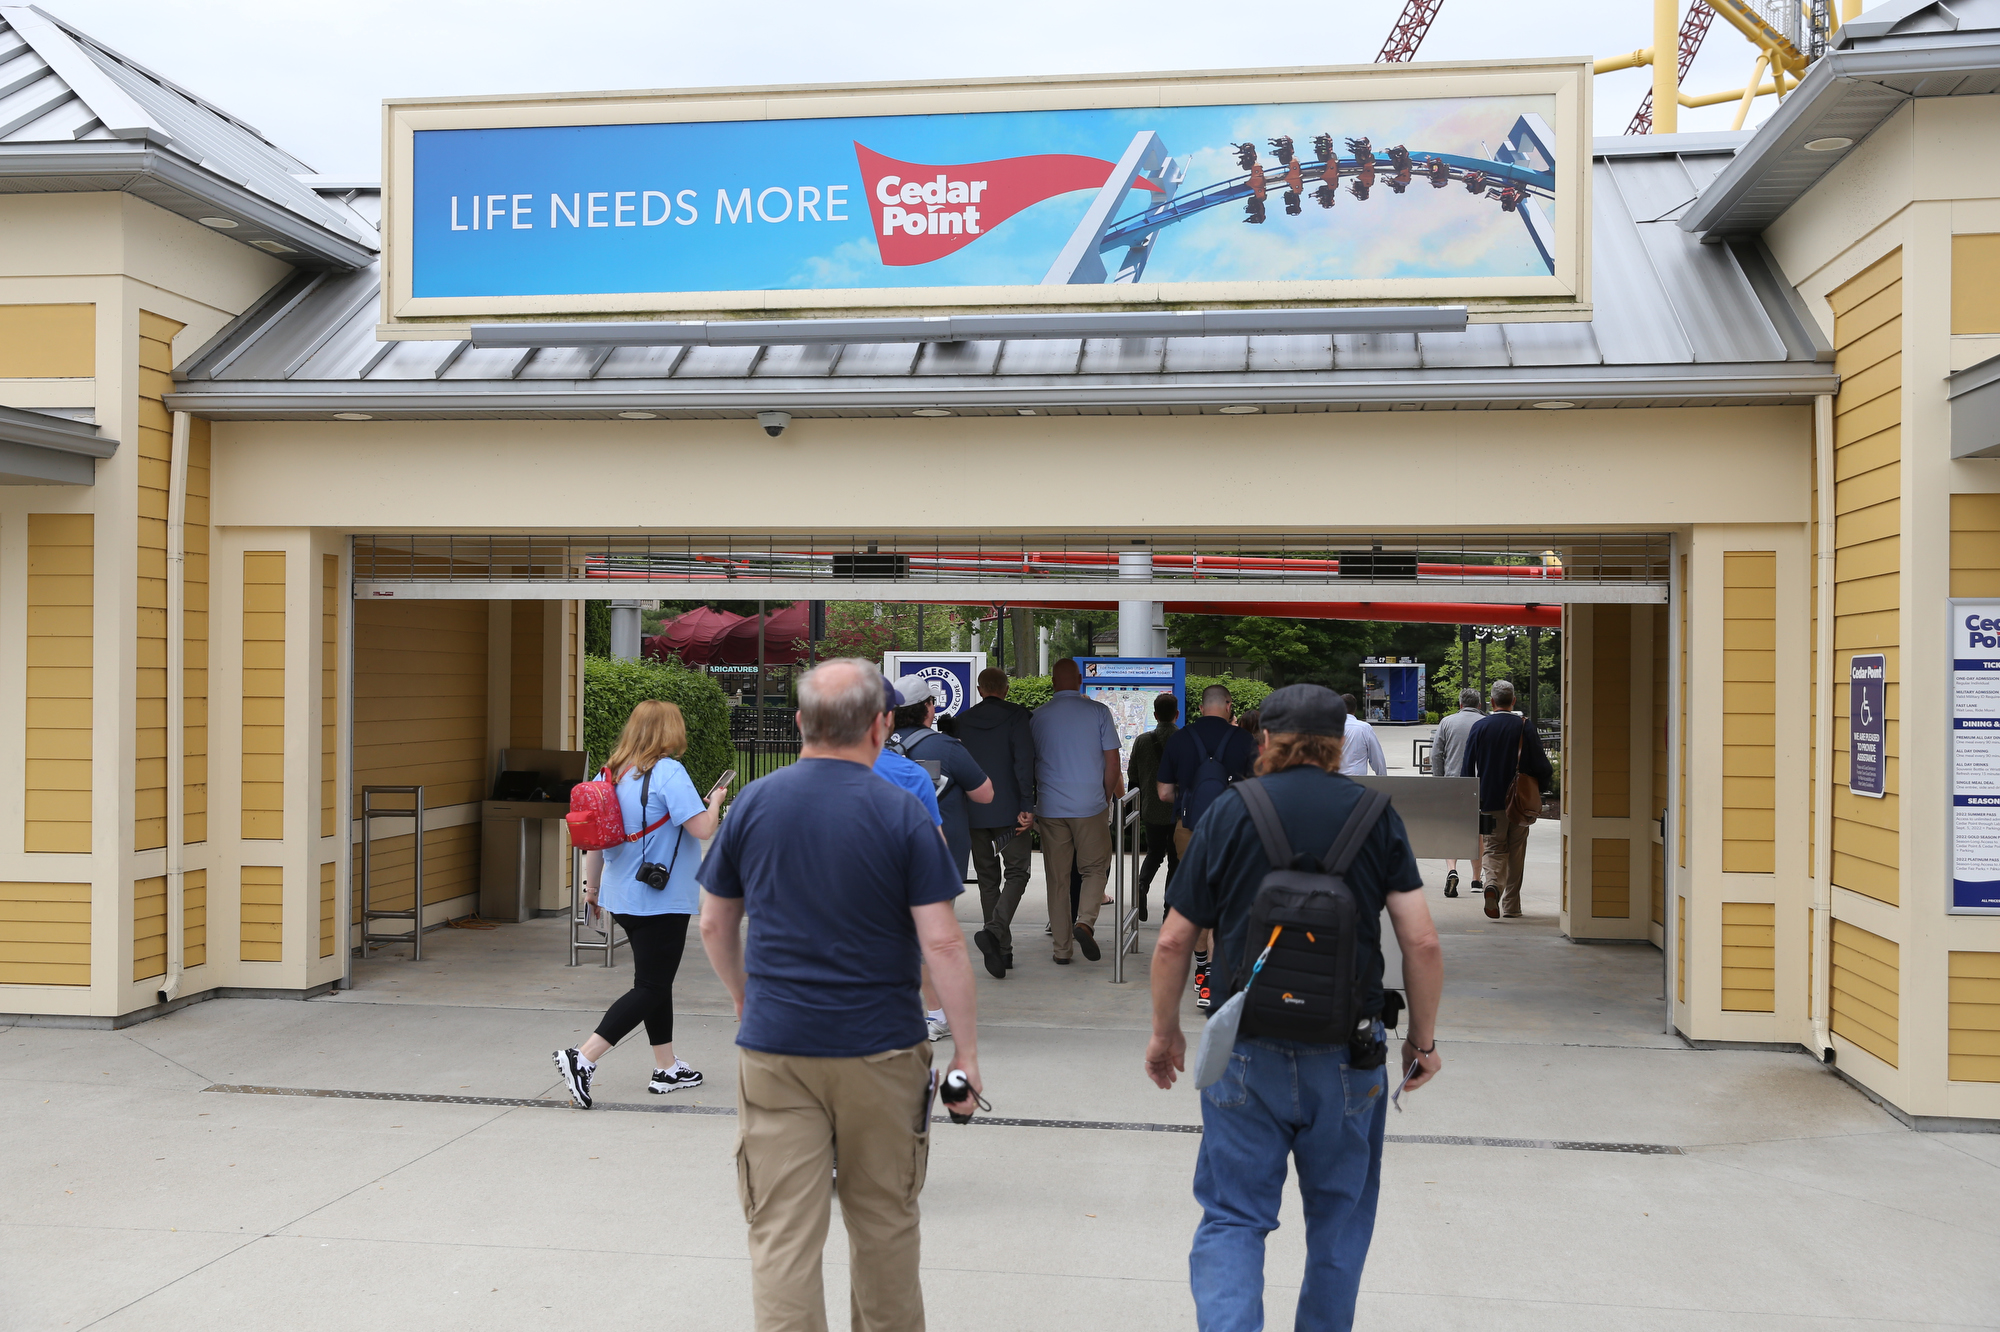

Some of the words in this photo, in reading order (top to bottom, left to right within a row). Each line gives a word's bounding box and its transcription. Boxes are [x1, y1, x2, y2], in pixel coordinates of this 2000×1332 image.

[876, 174, 988, 206] Cedar
[451, 194, 533, 231] LIFE
[550, 189, 698, 228] NEEDS
[714, 184, 849, 224] MORE
[882, 205, 981, 236] Point
[709, 665, 759, 673] ARICATURES
[917, 668, 950, 679] HLESS
[1852, 666, 1867, 679] Cedar
[1867, 665, 1882, 679] Point
[952, 684, 961, 711] SECURE
